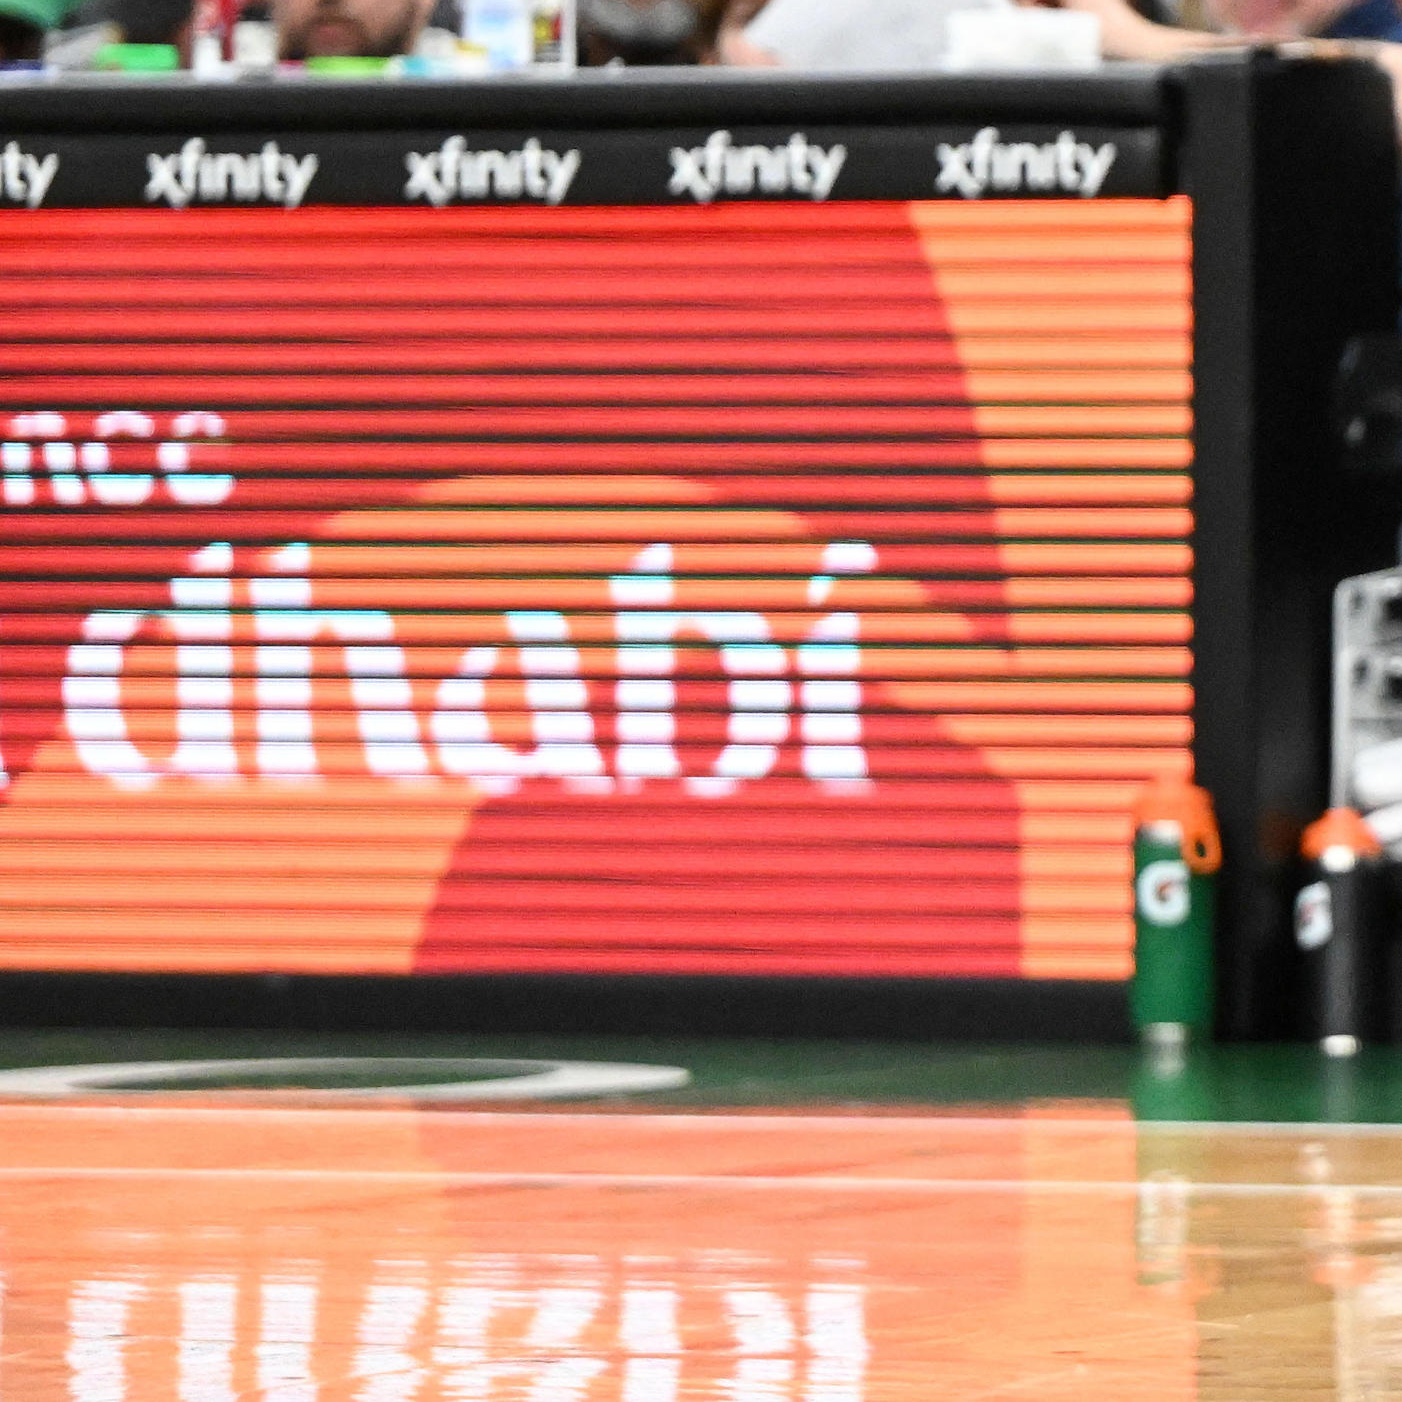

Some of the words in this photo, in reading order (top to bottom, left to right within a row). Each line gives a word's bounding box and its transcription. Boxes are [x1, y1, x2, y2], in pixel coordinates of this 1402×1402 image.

[0, 139, 60, 210] ty
[144, 135, 319, 210] xfinity
[403, 134, 583, 209] xfinity
[667, 128, 848, 203] xfinity
[934, 125, 1117, 200] xfinity
[61, 541, 879, 796] dhabi
